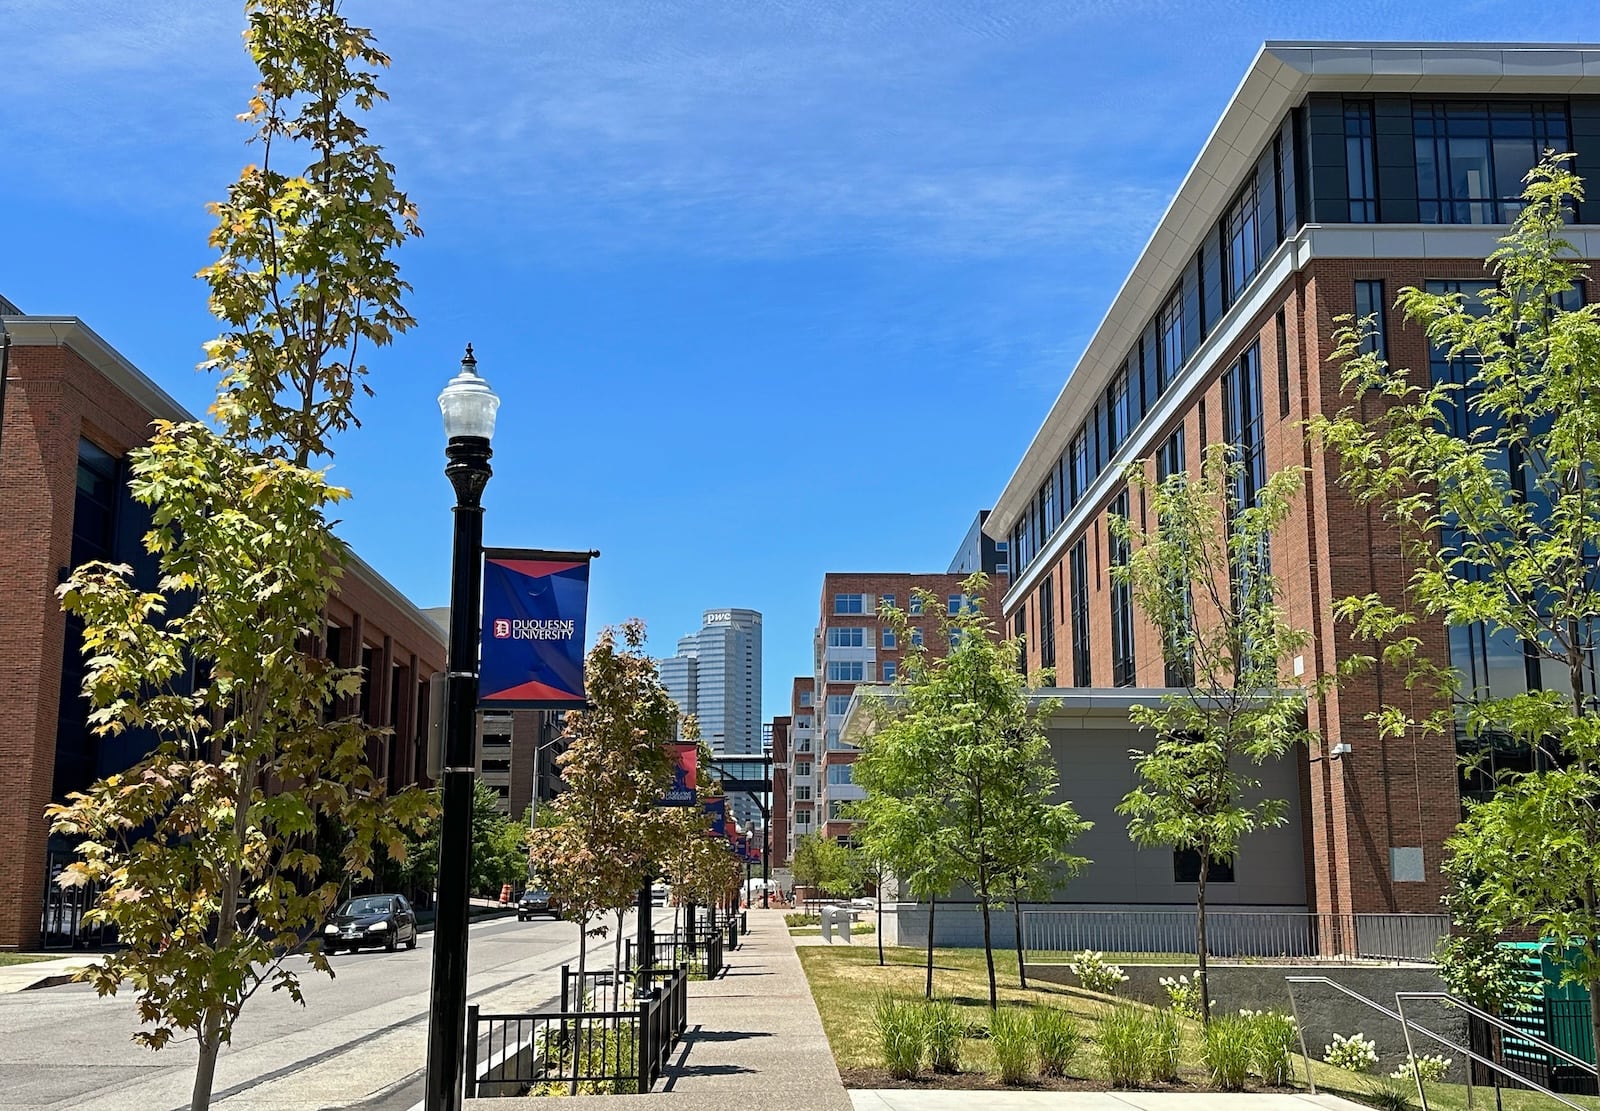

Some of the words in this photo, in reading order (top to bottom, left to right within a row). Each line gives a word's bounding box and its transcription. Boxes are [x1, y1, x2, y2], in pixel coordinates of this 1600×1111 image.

[707, 612, 731, 625] pwc
[512, 619, 575, 630] DUQUESNE
[512, 629, 575, 640] UNIVERSITY
